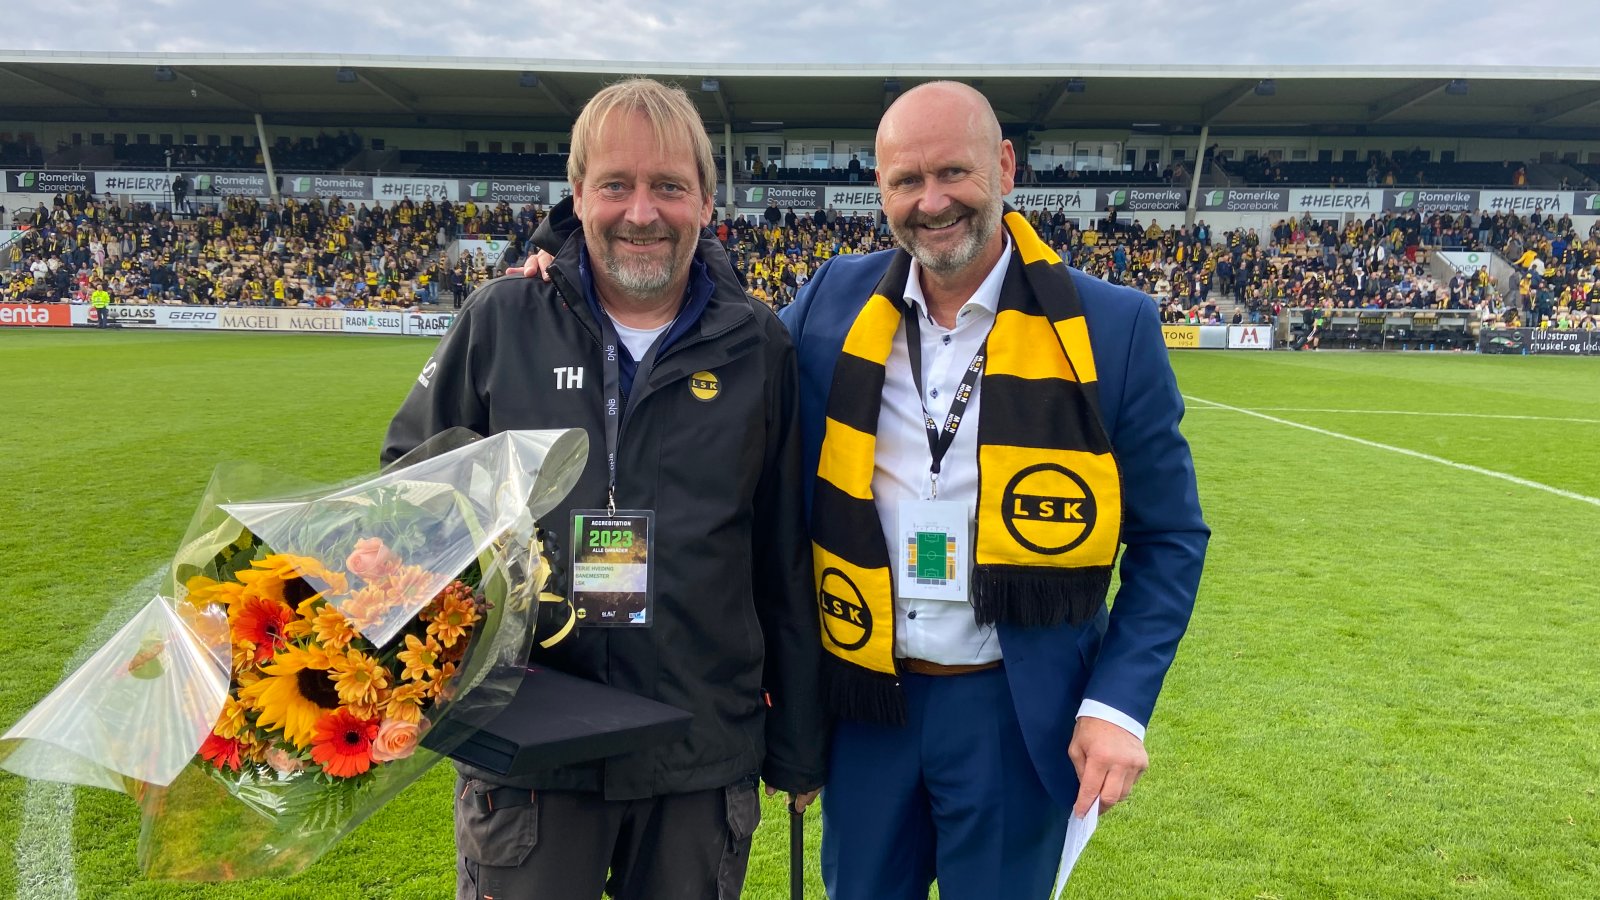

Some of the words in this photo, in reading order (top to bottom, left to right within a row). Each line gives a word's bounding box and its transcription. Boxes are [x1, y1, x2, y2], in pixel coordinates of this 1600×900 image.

[38, 173, 86, 182] Romerike
[105, 175, 171, 191] #HEIERPÅ
[214, 175, 264, 185] Romerike
[315, 178, 364, 188] Romerike
[38, 183, 86, 192] Sparebank
[214, 185, 264, 195] Sparebank
[315, 188, 364, 198] Sparebank
[382, 181, 448, 197] #HEIERPÅ
[491, 182, 540, 193] Romerike
[768, 187, 817, 197] Romerike
[491, 193, 540, 202] Sparebank
[1013, 190, 1081, 209] #HEIERPÅ
[1130, 190, 1181, 200] Romerike
[1228, 190, 1280, 200] Romerike
[1300, 192, 1370, 209] #HEIERPÅ
[1418, 191, 1470, 202] Romerike
[1129, 201, 1180, 211] Sparebank
[1227, 201, 1279, 211] Sparebank
[1417, 202, 1469, 212] Sparebank
[1491, 194, 1560, 211] #HEIERPÅ
[0, 304, 49, 323] enta
[110, 308, 155, 318] GLASS
[223, 315, 278, 329] MAGELI
[289, 316, 343, 330] MAGELI
[346, 316, 367, 327] RAGN
[377, 318, 400, 328] SELLS
[418, 318, 445, 330] RAGN
[1531, 331, 1578, 340] Lillestrøm
[605, 344, 616, 361] DNB
[1570, 343, 1581, 353] og
[553, 366, 584, 390] TH
[692, 379, 717, 390] LSK
[956, 383, 967, 401] ACTION
[606, 398, 618, 416] DNB
[944, 413, 954, 432] ACTION
[1013, 498, 1084, 520] LSK
[589, 530, 633, 548] 2023
[821, 592, 863, 625] LSK
